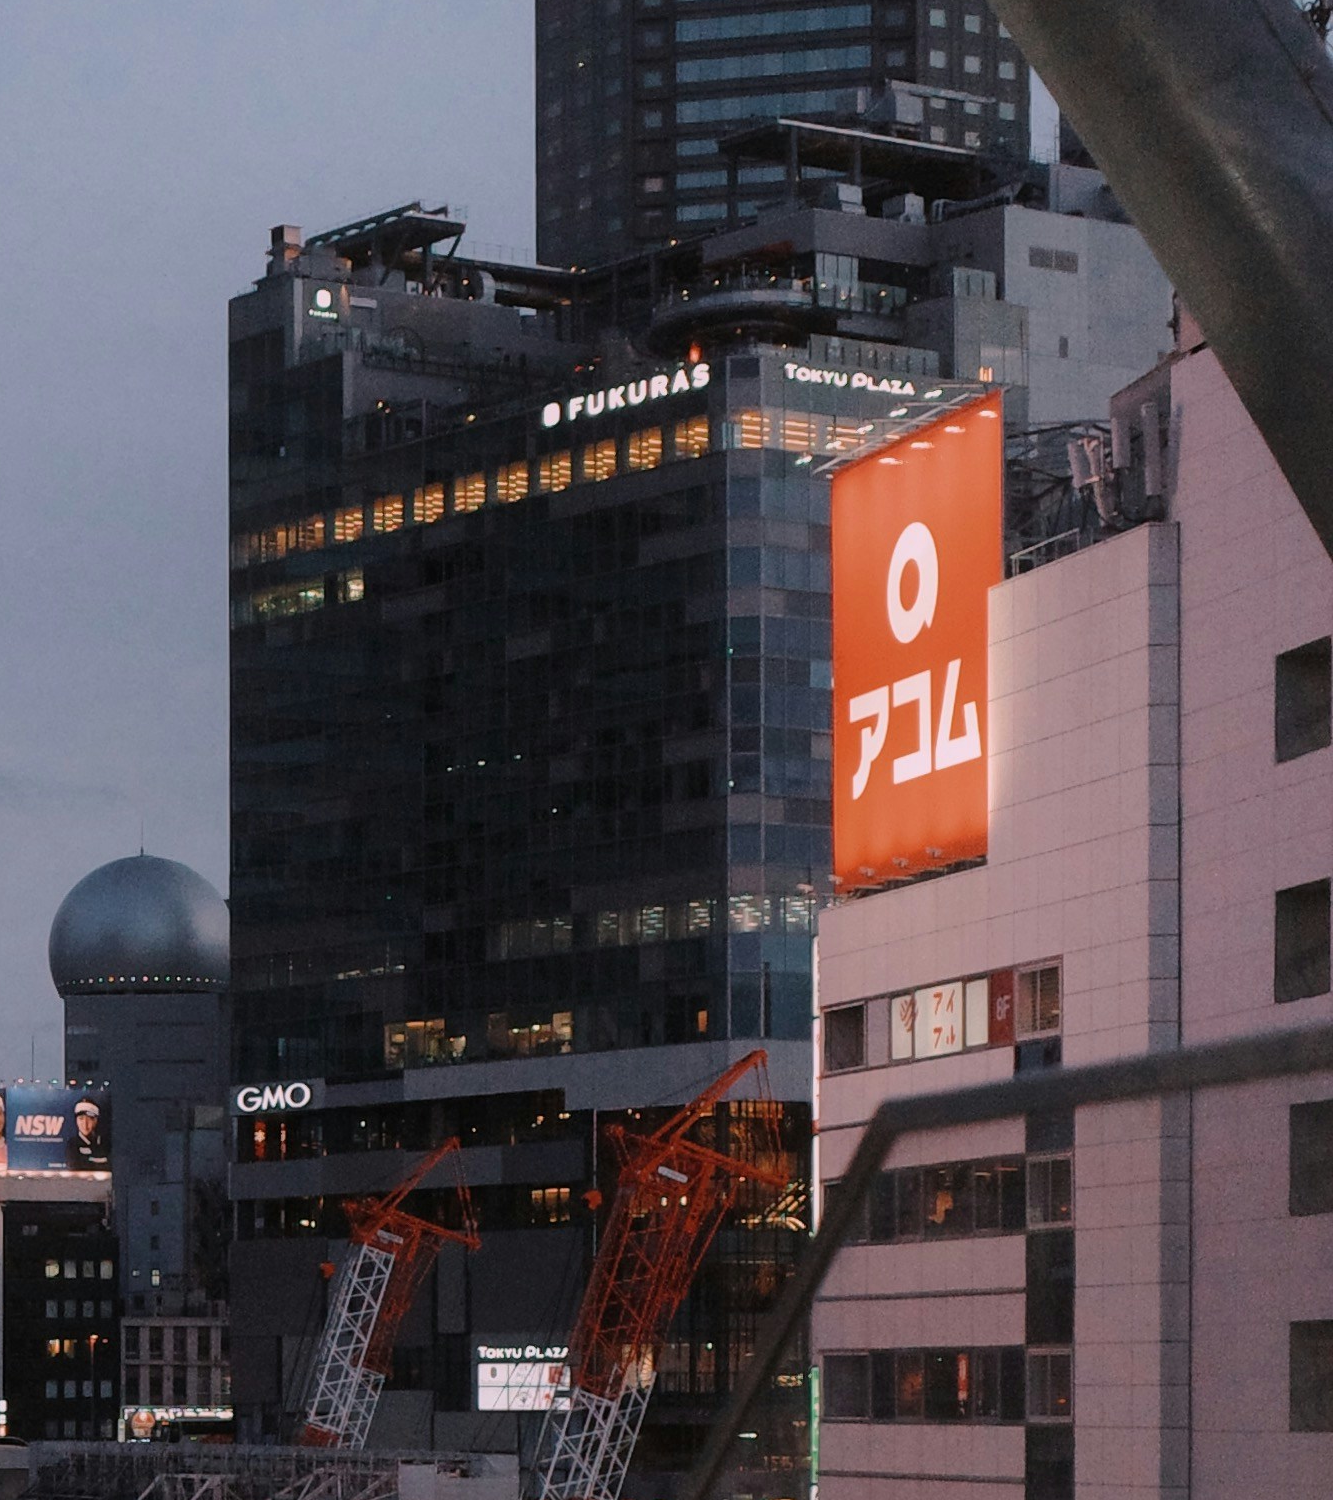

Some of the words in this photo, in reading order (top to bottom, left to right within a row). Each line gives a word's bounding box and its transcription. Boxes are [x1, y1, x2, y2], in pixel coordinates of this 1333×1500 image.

[568, 363, 711, 421] FUKURAS
[784, 362, 848, 388] TOKYU
[852, 371, 916, 396] PLAZA
[849, 658, 981, 800] アコム
[237, 1082, 311, 1112] GMO
[14, 1114, 65, 1136] NSW
[477, 1345, 523, 1360] TOKYU
